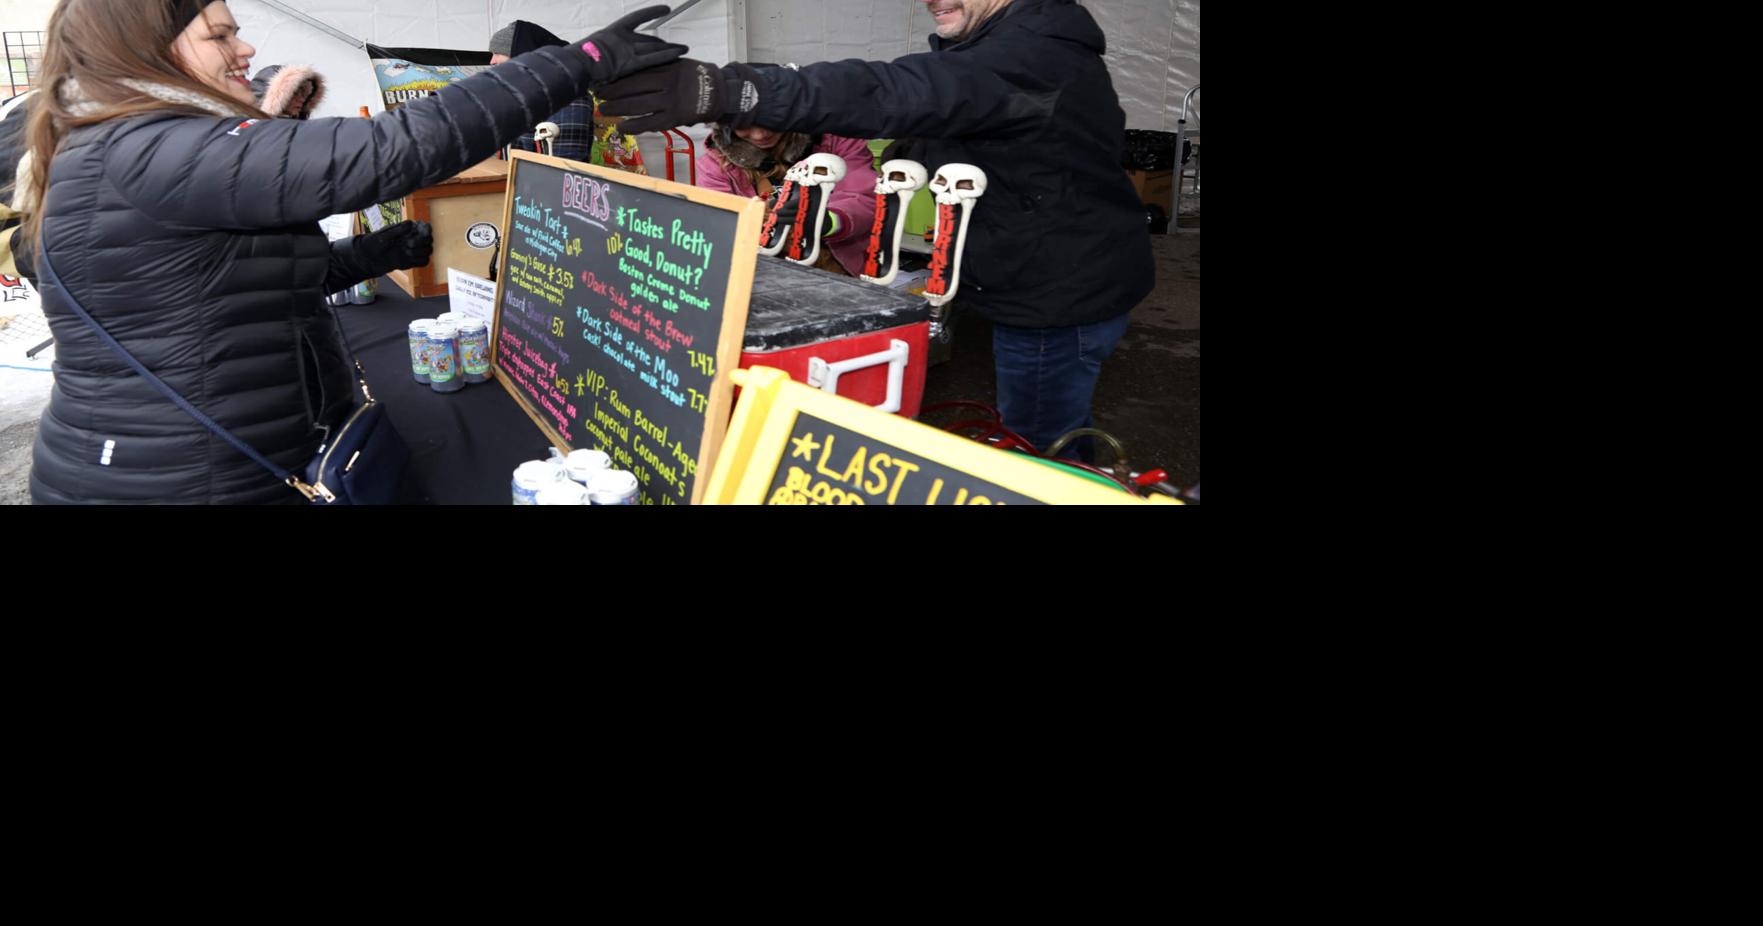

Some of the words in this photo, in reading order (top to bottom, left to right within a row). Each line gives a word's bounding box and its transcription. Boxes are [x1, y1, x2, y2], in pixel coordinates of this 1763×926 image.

[384, 90, 429, 104] BURN
[544, 208, 562, 235] Tart
[562, 172, 610, 222] BEERS
[625, 238, 653, 267] Good,
[656, 251, 703, 291] Donut?
[627, 208, 664, 239] Tastes
[671, 218, 713, 270] Pretty
[587, 272, 607, 297] Dark
[609, 286, 628, 310] Side
[632, 304, 643, 316] of
[644, 310, 661, 331] the
[665, 320, 694, 347] Brew
[618, 257, 644, 281] Boston
[679, 288, 711, 311] Donut
[630, 282, 659, 304] golden
[662, 298, 679, 313] ale
[582, 308, 602, 332] Dark
[604, 321, 622, 345] Side
[626, 341, 635, 354] of
[635, 345, 651, 366] the
[654, 355, 680, 388] Moo
[610, 308, 640, 333] oatmeal
[645, 328, 672, 353] stout
[603, 342, 636, 373] chocolate
[640, 370, 658, 389] milk
[661, 384, 686, 407] stout
[687, 350, 715, 377] 7.4%
[586, 368, 609, 400] VIP:
[609, 389, 631, 419] Rum
[594, 401, 628, 443] Imperial
[586, 419, 613, 451] coconut
[614, 445, 633, 469] pale
[634, 465, 650, 486] ale
[816, 434, 920, 505] LAST
